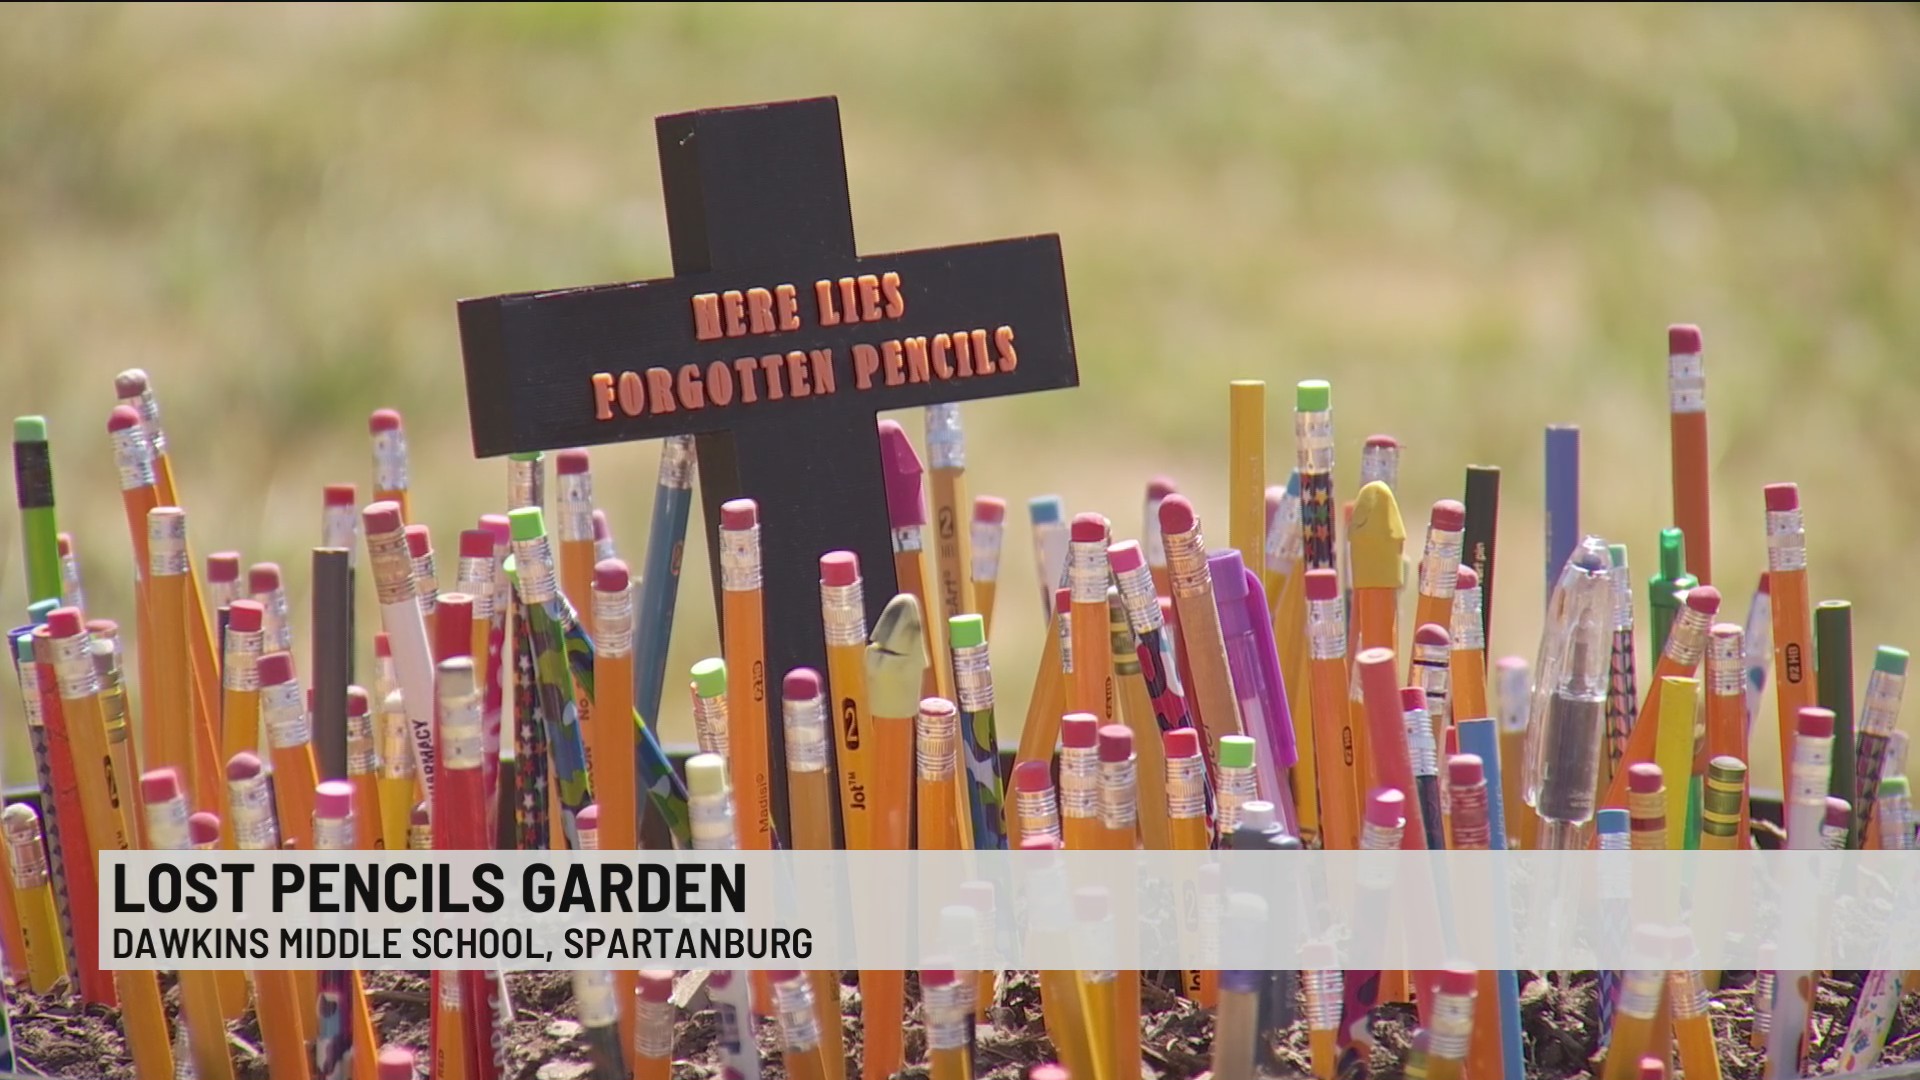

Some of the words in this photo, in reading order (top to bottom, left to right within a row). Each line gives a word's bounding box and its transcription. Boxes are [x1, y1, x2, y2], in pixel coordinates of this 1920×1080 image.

[692, 284, 801, 341] HERE
[814, 272, 906, 327] LIES
[591, 348, 836, 421] FORGOTTEN
[851, 326, 1018, 391] PENCILS
[844, 702, 859, 746] 2
